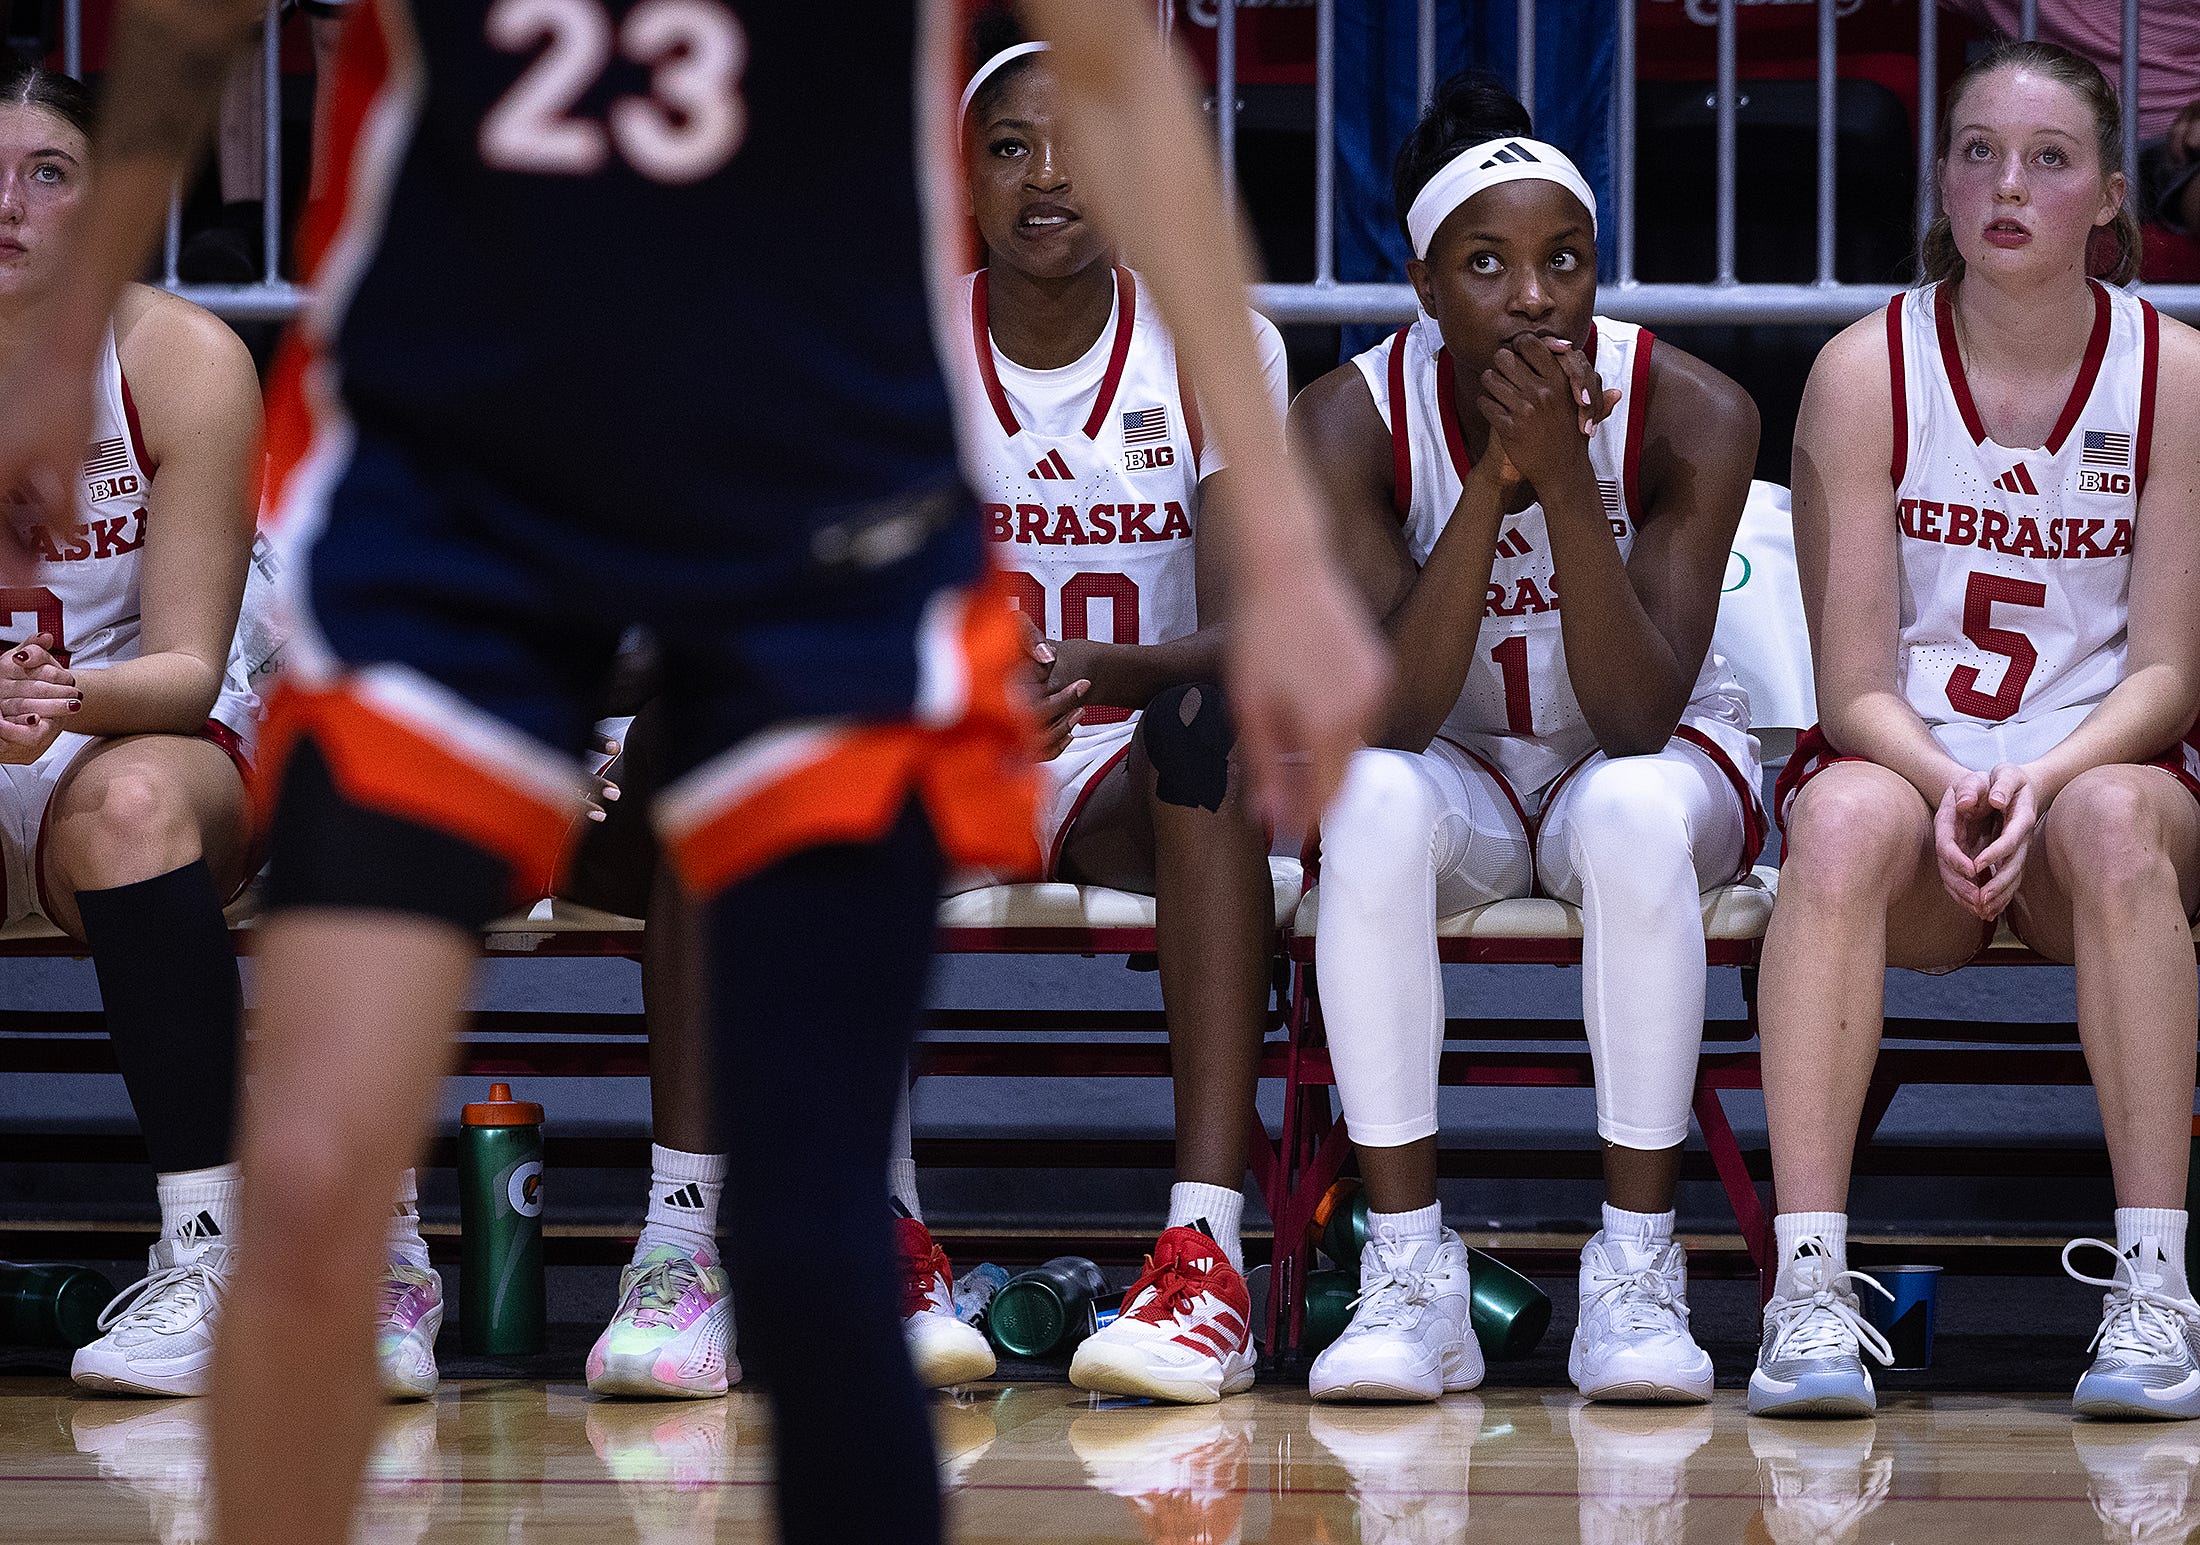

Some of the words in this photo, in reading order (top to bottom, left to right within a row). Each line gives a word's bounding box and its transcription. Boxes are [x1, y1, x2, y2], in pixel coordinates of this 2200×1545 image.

[477, 0, 750, 184] 23
[983, 501, 1192, 546] BRASKA
[1898, 498, 2132, 560] NEBRASKA
[1491, 635, 1535, 738] 1
[1945, 570, 2047, 722] 5
